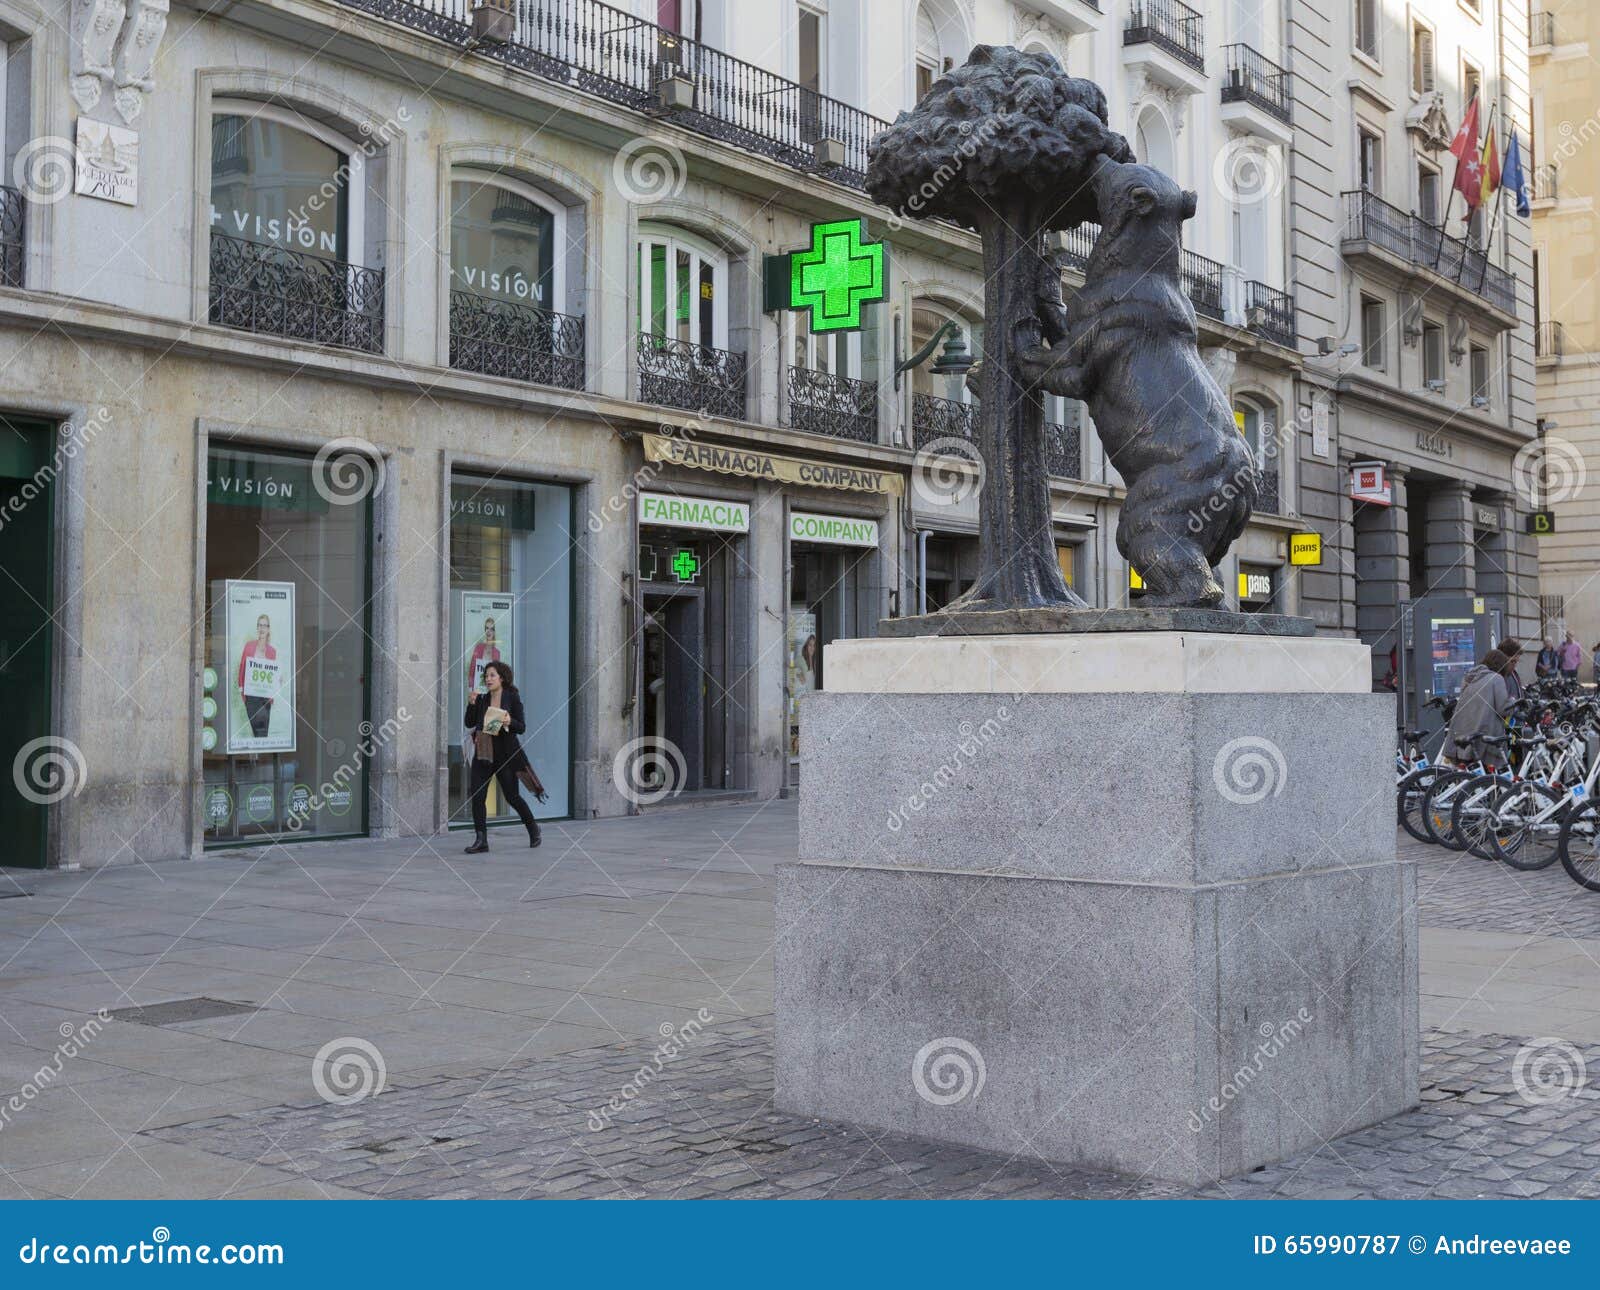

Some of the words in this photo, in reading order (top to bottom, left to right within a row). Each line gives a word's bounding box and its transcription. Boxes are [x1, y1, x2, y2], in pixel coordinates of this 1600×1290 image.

[233, 210, 336, 252] VISIÓN
[464, 265, 543, 301] VISIÓN
[671, 444, 775, 476] FARMACIA
[799, 463, 883, 489] COMPANY
[220, 477, 293, 497] VISIÓN
[643, 497, 745, 527] FARMACIA
[792, 517, 874, 541] COMPANY
[1293, 543, 1318, 554] pans
[1247, 574, 1271, 598] pans
[249, 661, 263, 669] The
[264, 664, 279, 672] one
[252, 670, 273, 683] 89€
